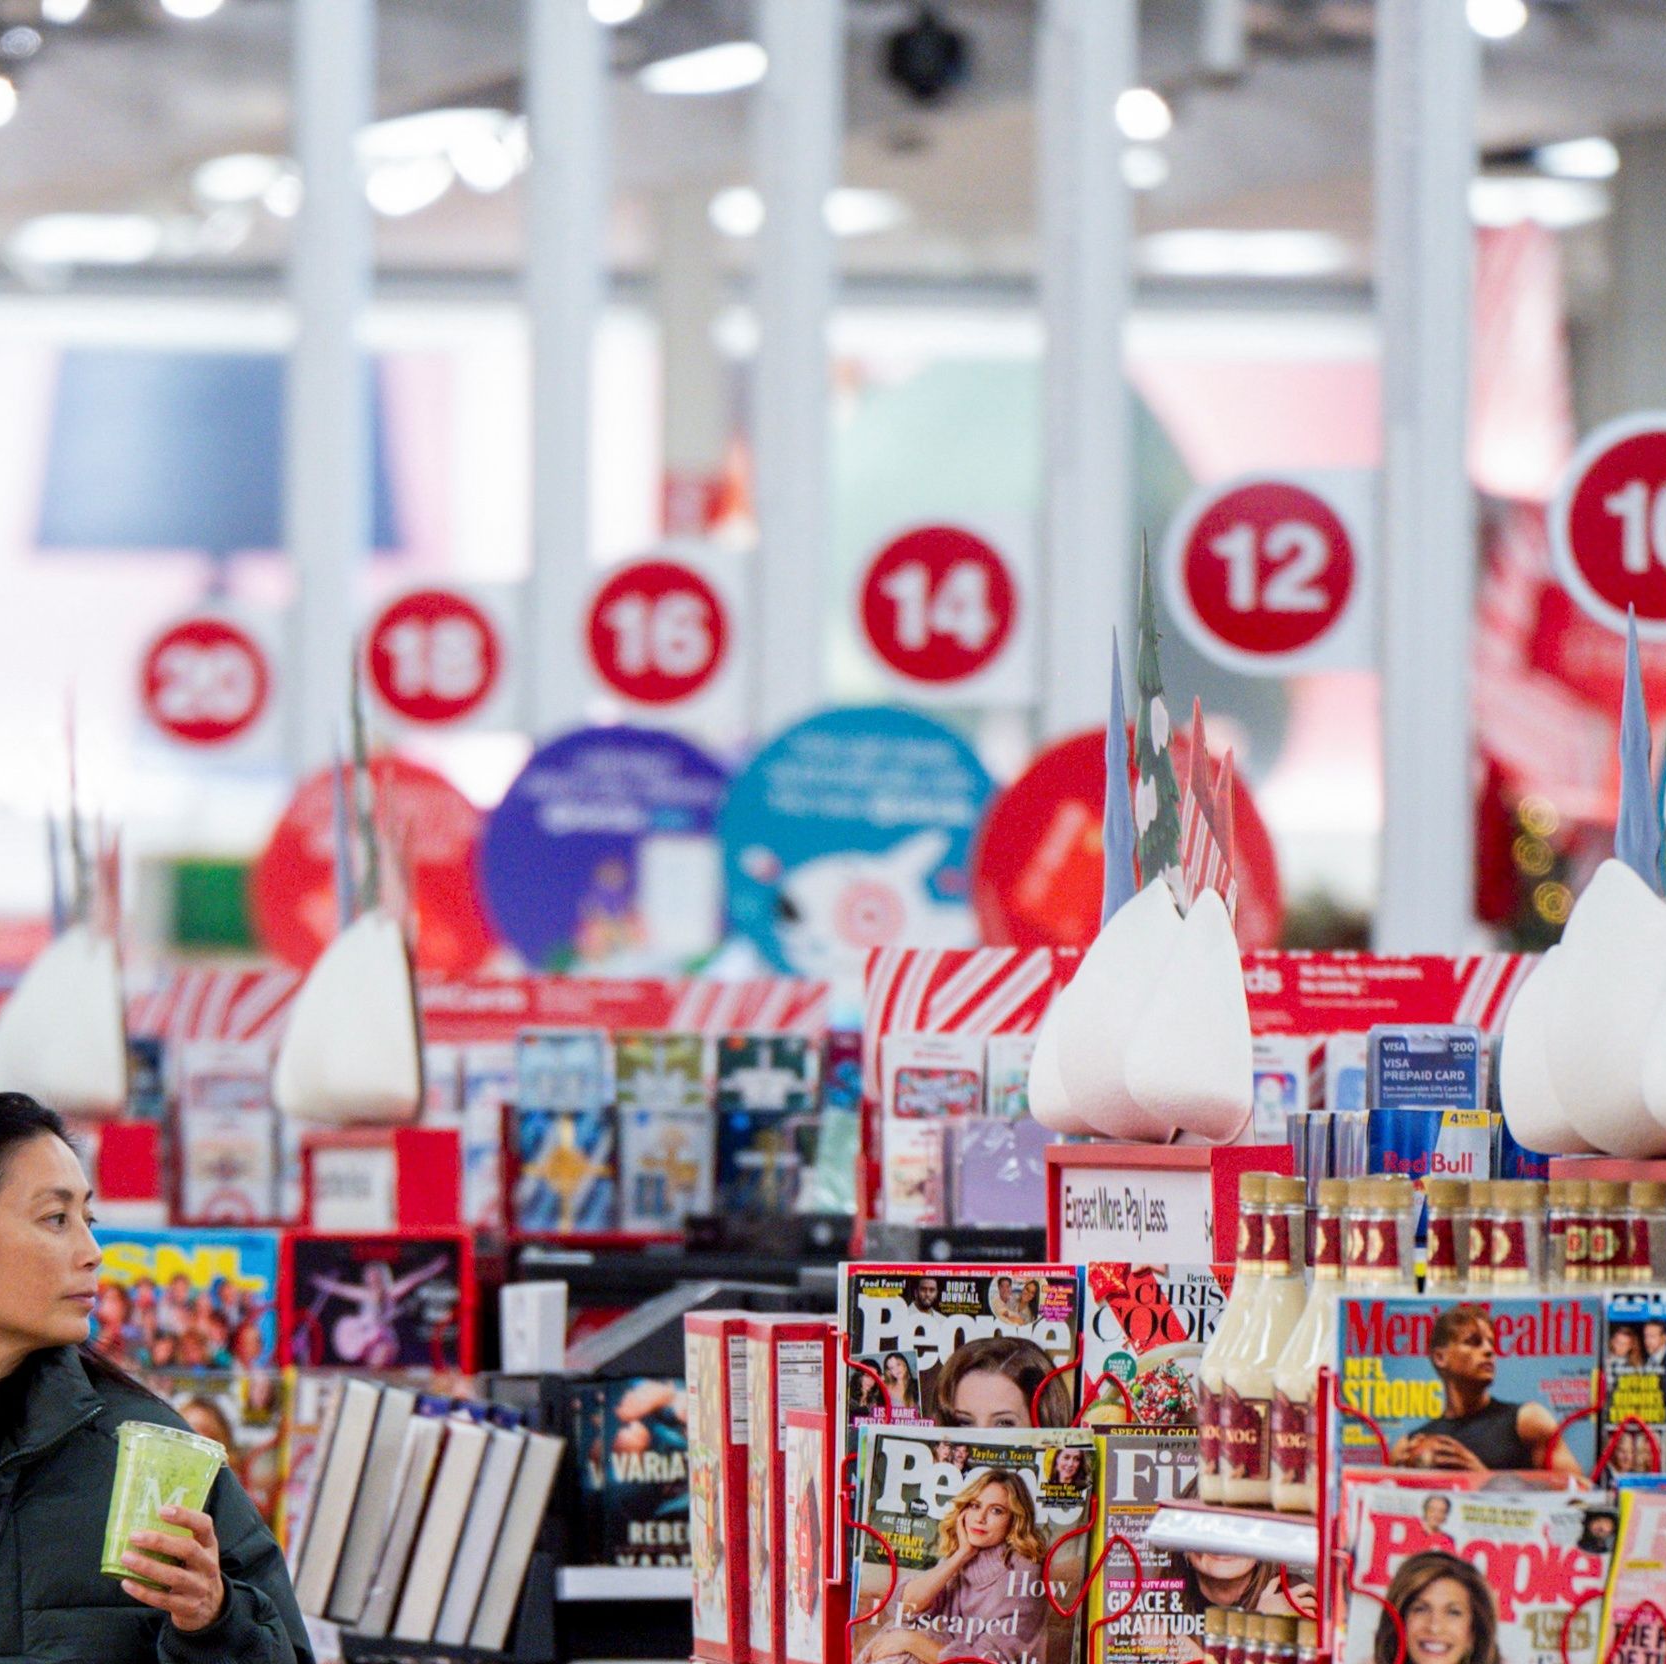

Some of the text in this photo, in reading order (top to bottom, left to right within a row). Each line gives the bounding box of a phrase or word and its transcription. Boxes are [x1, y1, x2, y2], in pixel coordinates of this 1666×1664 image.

[1210, 523, 1330, 612] 12
[881, 564, 995, 650] 14
[605, 593, 711, 673] 16
[379, 615, 480, 698] 18
[156, 640, 255, 716] 20
[1382, 1042, 1406, 1052] VISA
[1383, 1059, 1410, 1069] VISA
[1383, 1070, 1466, 1082] PREPAID CARD
[1449, 1113, 1459, 1124] 4
[1383, 1151, 1473, 1174] Red Bull
[1065, 1186, 1097, 1240] Expect
[1124, 1187, 1142, 1242] Pay
[100, 1242, 266, 1293] SNL
[1187, 1273, 1216, 1284] Better
[941, 1292, 979, 1303] DOWNFALL
[945, 1281, 977, 1293] DIDDY'S
[1135, 1283, 1229, 1306] CHRIS
[857, 1293, 1073, 1373] Peope
[1346, 1300, 1595, 1357] Men' ealth
[1343, 1357, 1386, 1380] NFL
[1342, 1379, 1445, 1420] STRONG
[1110, 1427, 1161, 1437] SPECIAL
[972, 1448, 1034, 1461] Taylor Travis
[1156, 1441, 1191, 1450] HAPPY
[613, 1449, 687, 1483] VARIA
[1107, 1516, 1122, 1527] Fix
[881, 1531, 925, 1547] BETHANY
[898, 1548, 924, 1561] LENZ
[1005, 1570, 1071, 1599] How
[1108, 1580, 1129, 1589] TRUE
[1108, 1591, 1184, 1613] GRACE &
[893, 1602, 1020, 1644] Escaped
[1108, 1614, 1206, 1636] GRATITUDE
[1614, 1622, 1651, 1649] THE
